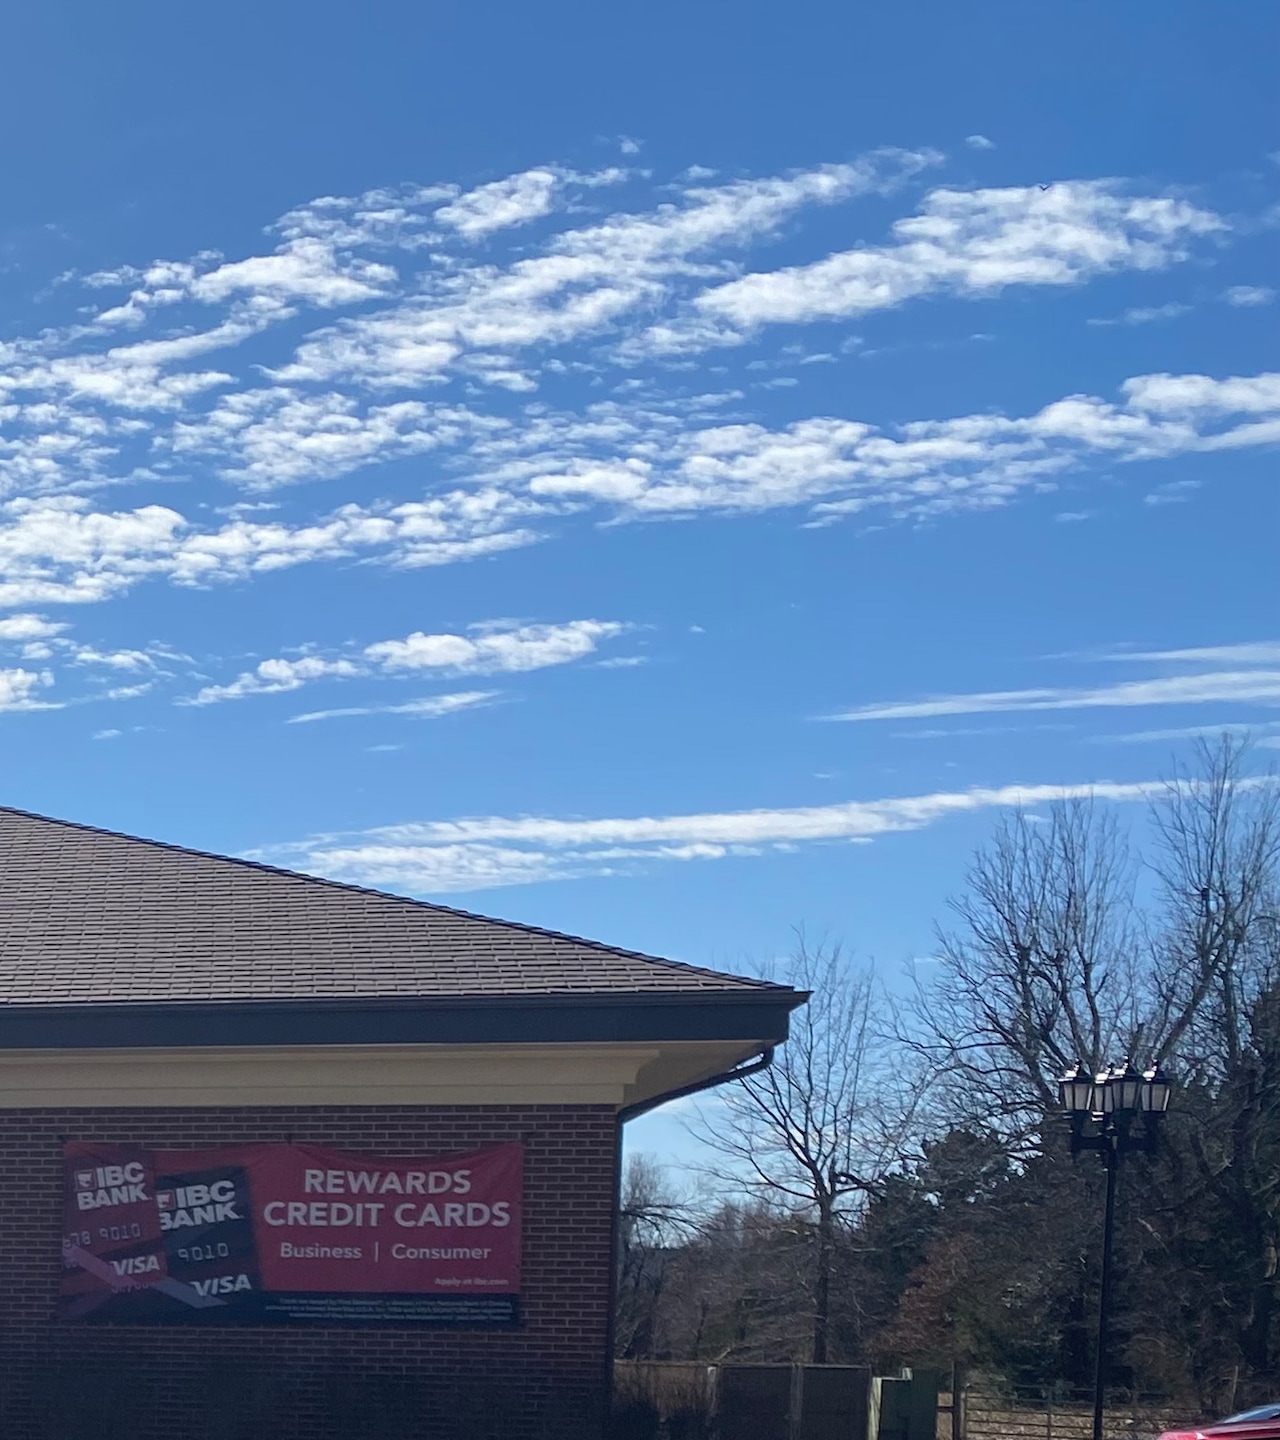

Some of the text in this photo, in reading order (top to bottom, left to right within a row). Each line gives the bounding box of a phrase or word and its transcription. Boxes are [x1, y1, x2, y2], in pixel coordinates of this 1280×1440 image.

[97, 1162, 145, 1189] IBC
[304, 1169, 472, 1195] REWARDS
[77, 1183, 150, 1211] BANK
[176, 1180, 236, 1208] IBC
[159, 1202, 241, 1231] BANK
[263, 1201, 511, 1228] CREDIT CARDS
[99, 1223, 141, 1241] 9010
[178, 1242, 230, 1263] 9010
[280, 1242, 492, 1260] Business Consumer
[110, 1255, 161, 1277] VISA
[189, 1273, 252, 1297] VISA
